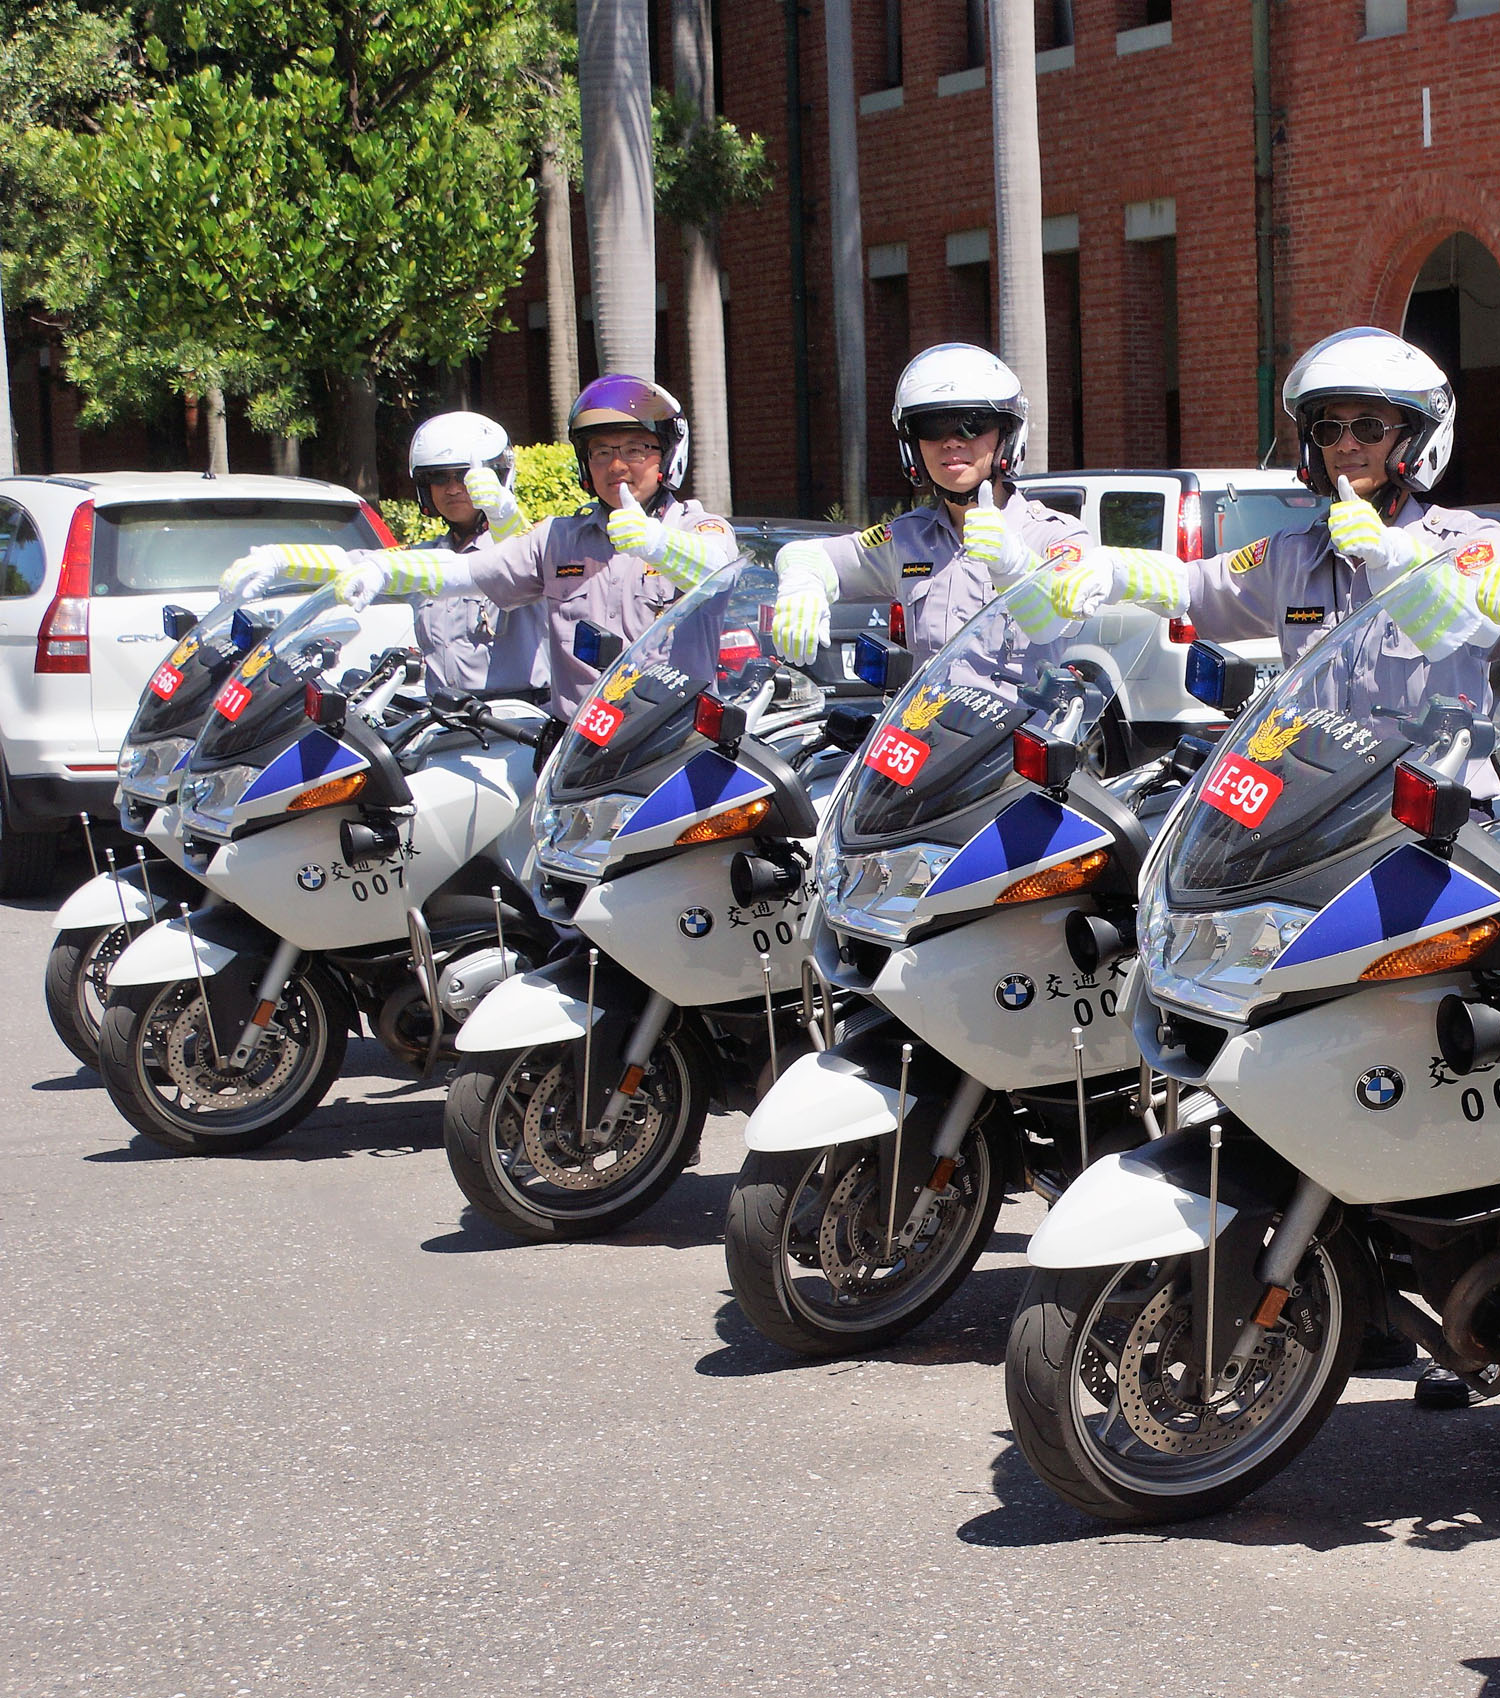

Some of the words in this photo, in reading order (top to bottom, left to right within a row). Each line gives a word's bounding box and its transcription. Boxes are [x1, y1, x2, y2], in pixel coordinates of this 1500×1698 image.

[869, 732, 920, 775] LF-55
[1206, 761, 1269, 815] LE-99
[351, 866, 404, 902] 007
[1300, 1308, 1314, 1333] BMW
